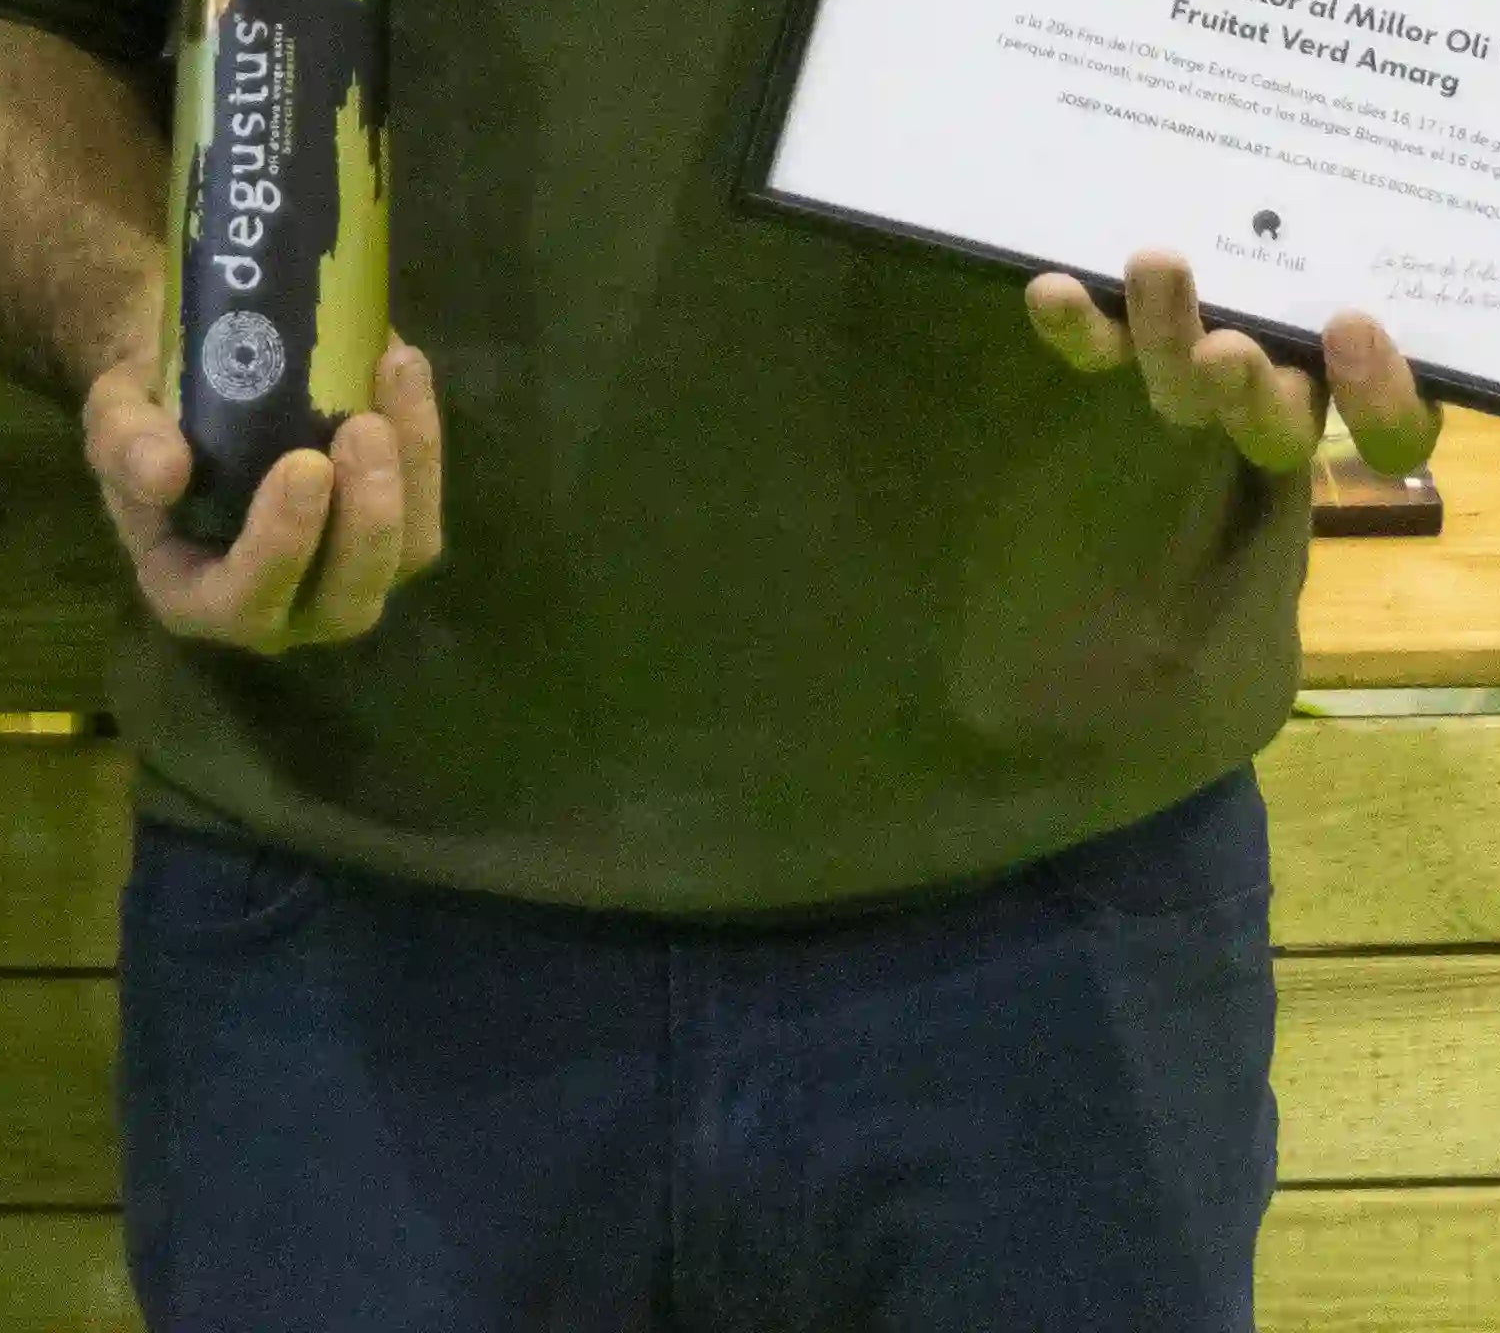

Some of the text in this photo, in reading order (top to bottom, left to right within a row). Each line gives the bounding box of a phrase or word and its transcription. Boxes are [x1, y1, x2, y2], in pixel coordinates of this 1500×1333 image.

[1281, 24, 1350, 64] Verd
[1354, 46, 1460, 98] Amarg
[1343, 2, 1438, 45] Millor
[1444, 28, 1490, 60] Oli
[213, 18, 281, 289] degustus
